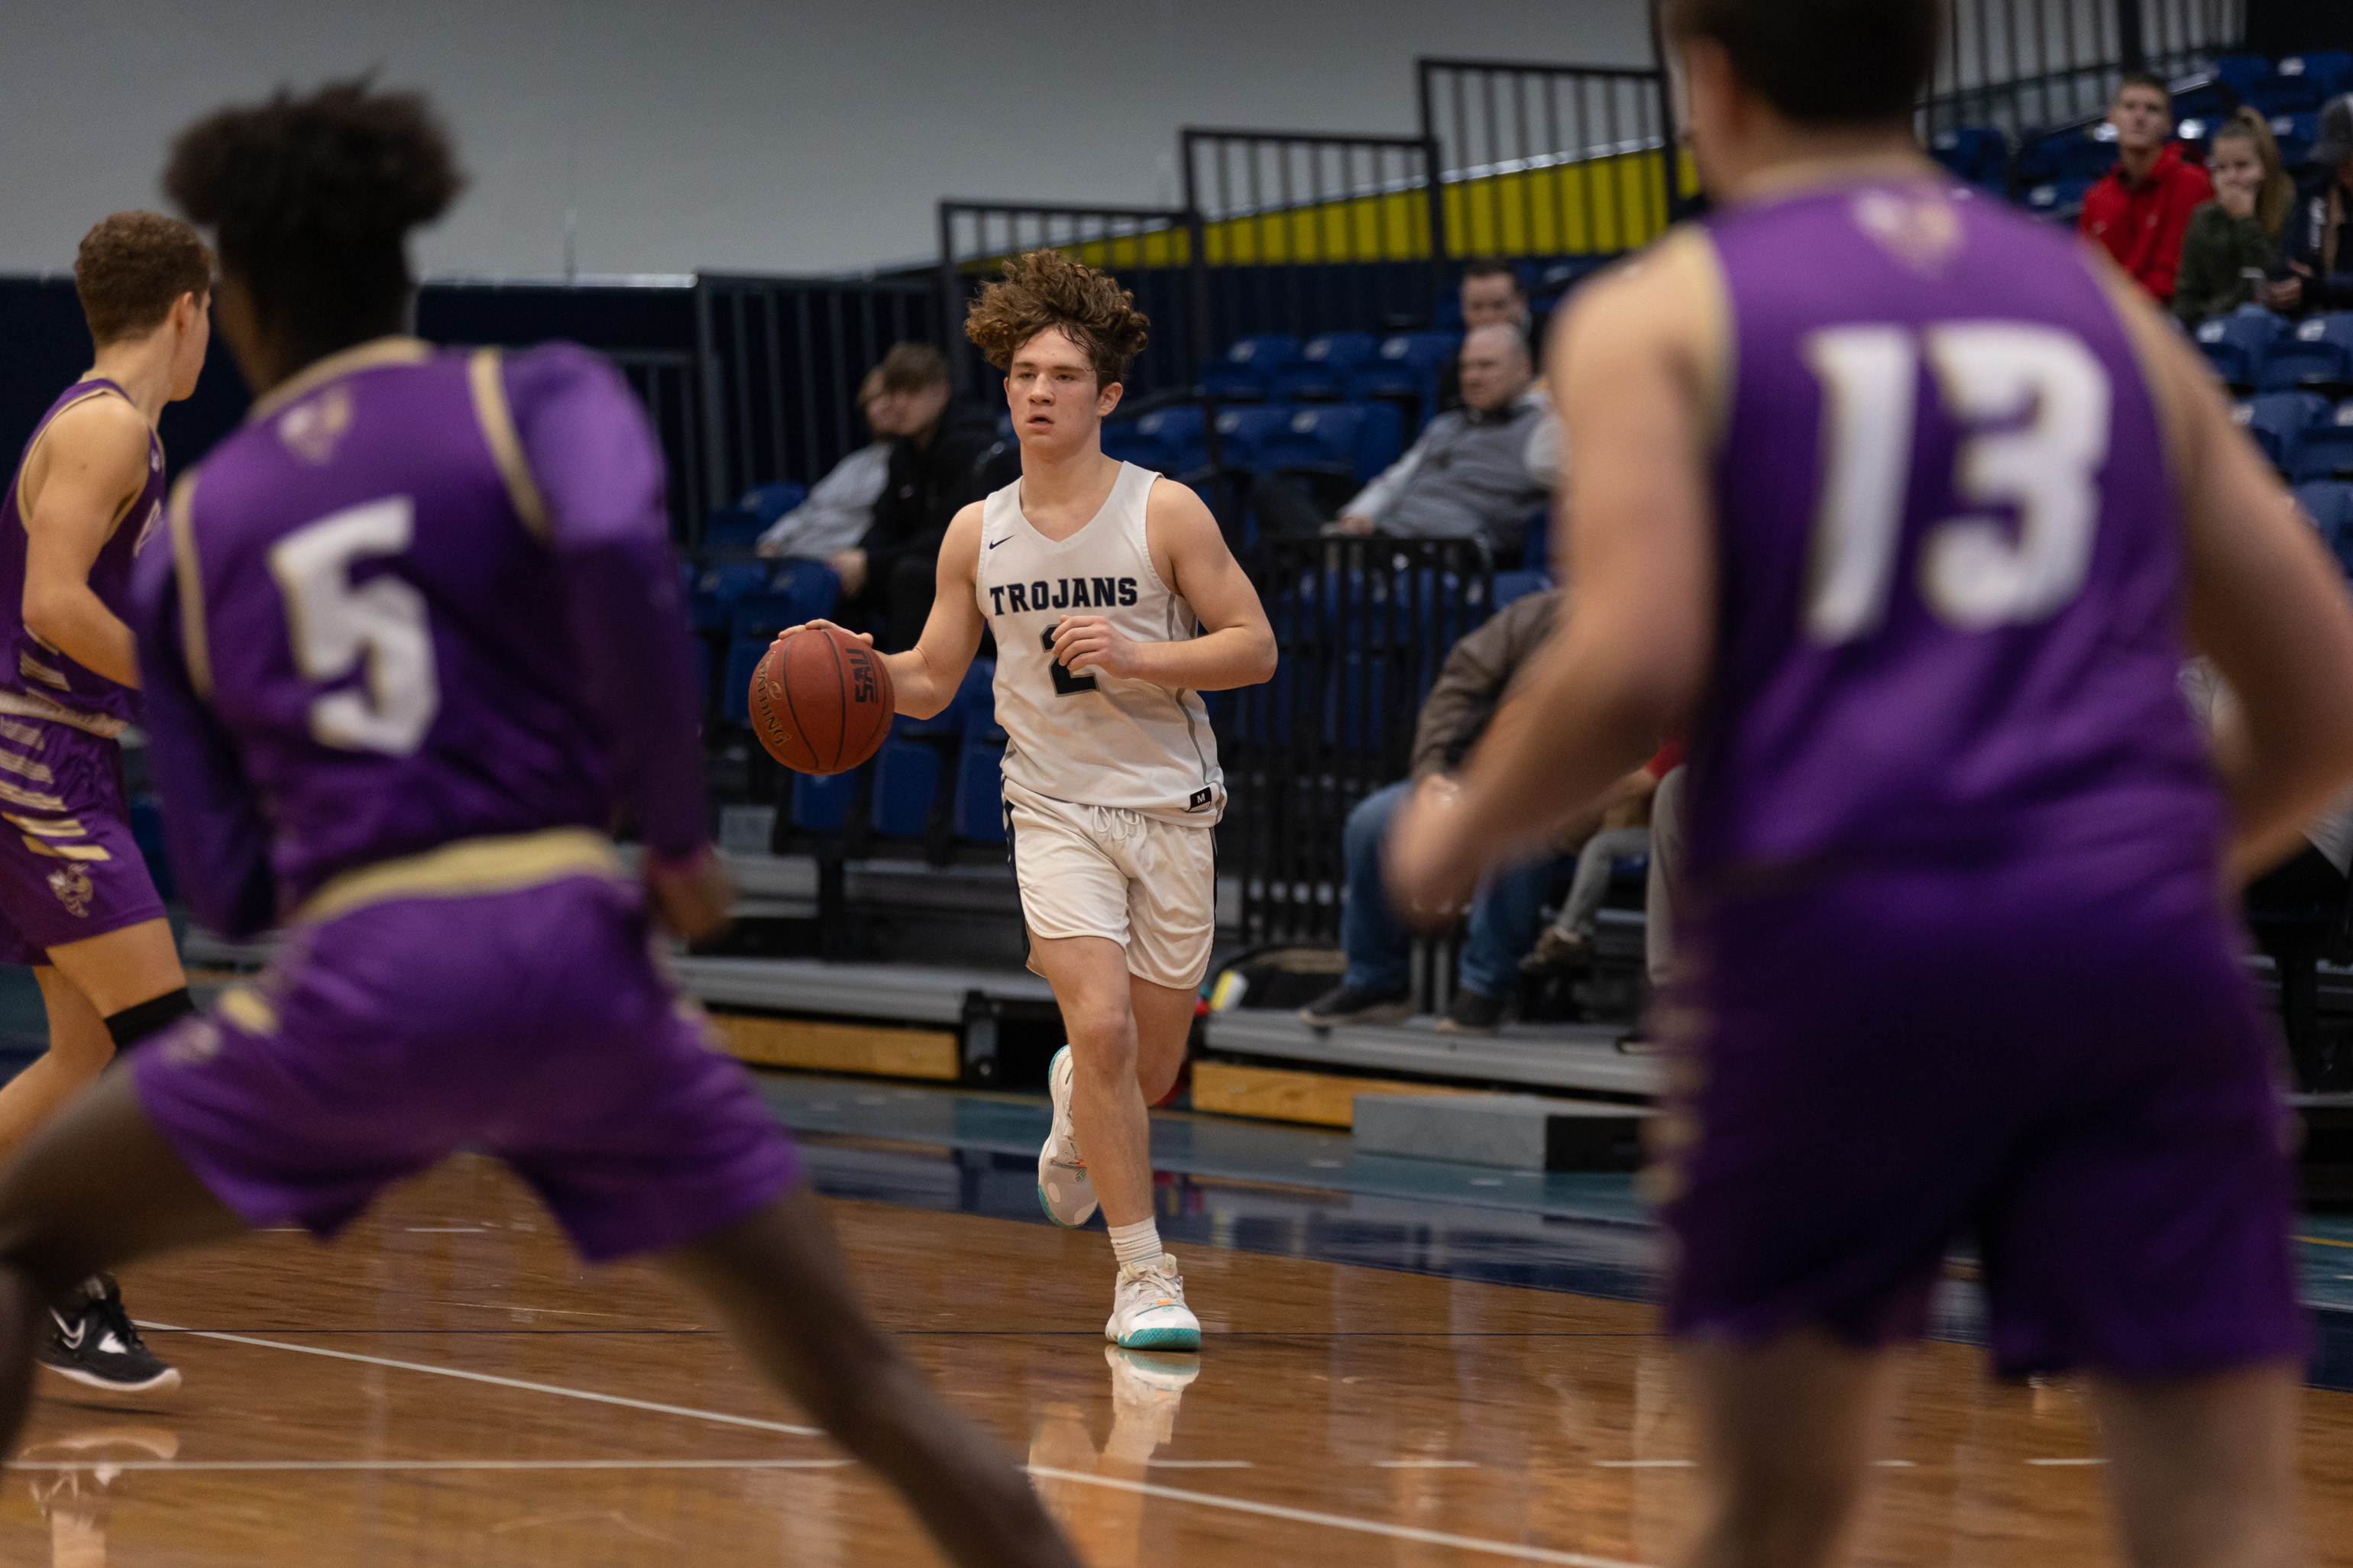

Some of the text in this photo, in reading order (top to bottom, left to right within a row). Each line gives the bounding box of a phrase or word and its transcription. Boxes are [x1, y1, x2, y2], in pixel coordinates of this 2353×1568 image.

[1801, 321, 2113, 648] 13
[266, 496, 442, 755] 5
[990, 577, 1138, 616] TROJANS
[846, 648, 875, 703] SAU
[1040, 623, 1100, 698] 2
[1196, 793, 1206, 804] M
